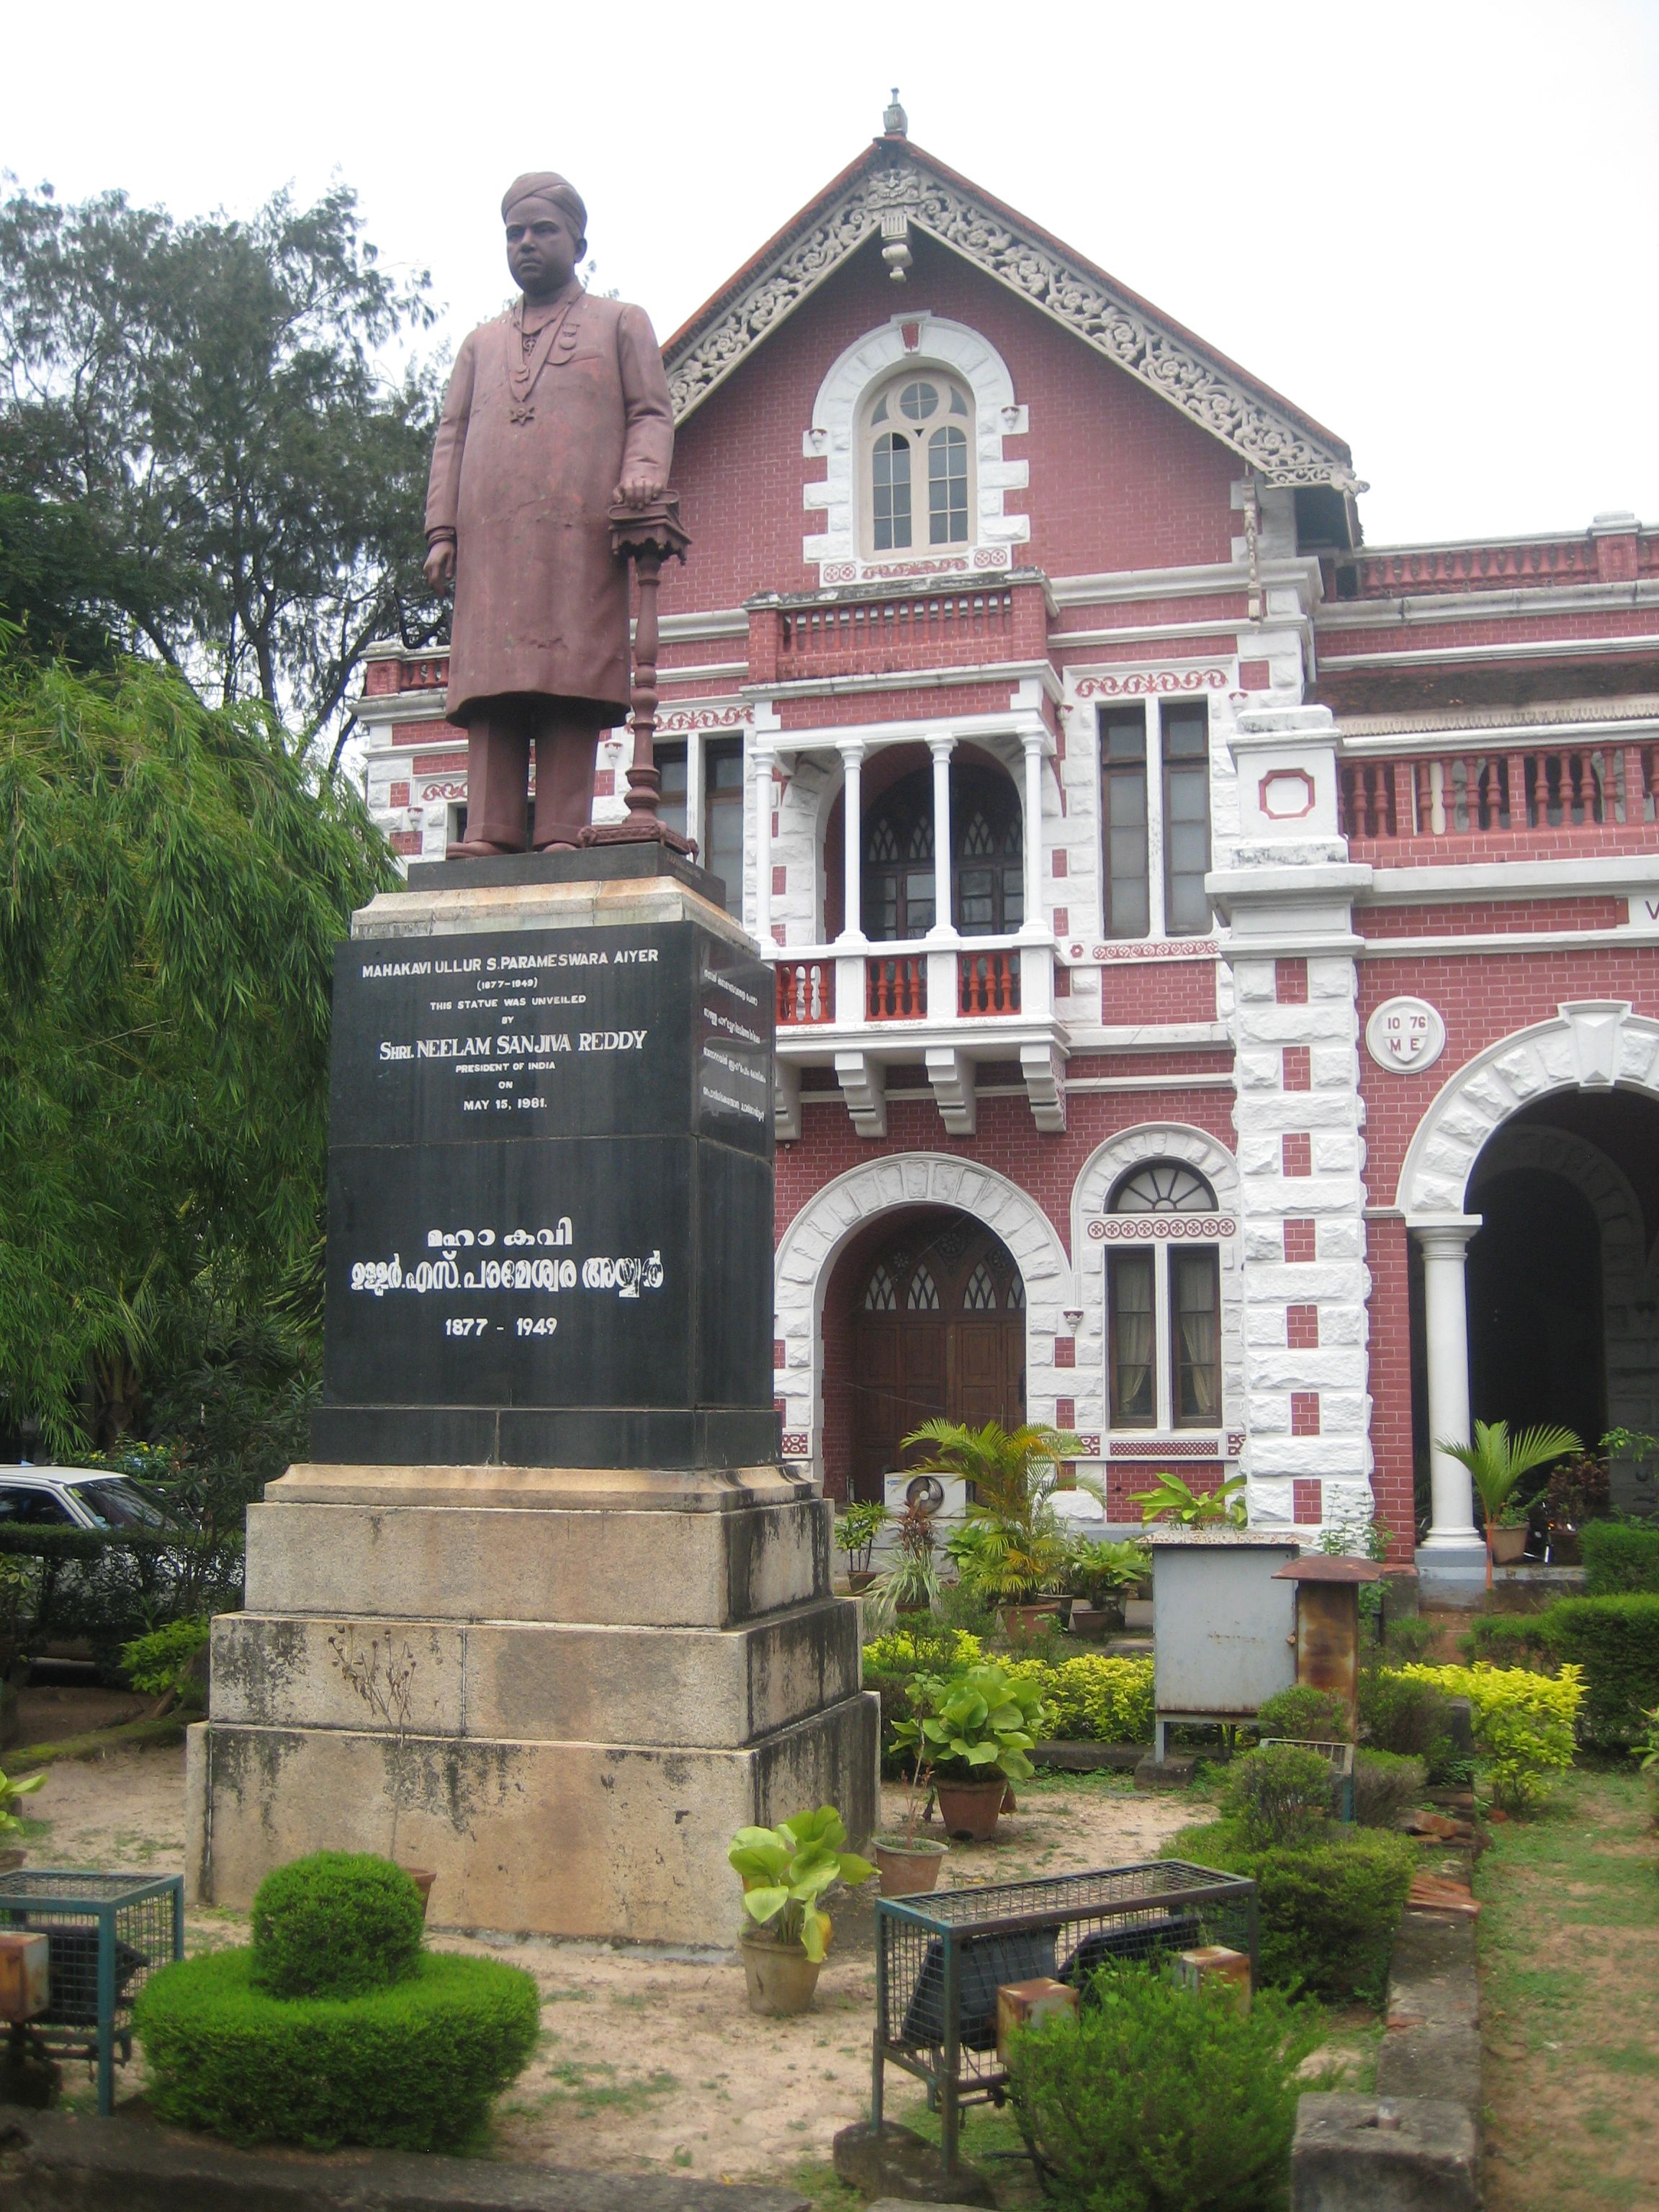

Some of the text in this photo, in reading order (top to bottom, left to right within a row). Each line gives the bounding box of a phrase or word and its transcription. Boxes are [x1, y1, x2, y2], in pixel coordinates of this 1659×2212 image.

[362, 949, 659, 978] MAHAKAVI ULLUR S.PARAMESWARA AIYER
[430, 994, 587, 1011] THIS STATUE WAS UNVEILED
[501, 1016, 514, 1025] BY
[1409, 1016, 1426, 1028] 76
[416, 1036, 492, 1058] NEELAM
[496, 1033, 572, 1055] SANJIVA
[577, 1030, 648, 1051] REDDY
[1390, 1038, 1420, 1051] M E
[455, 1061, 556, 1074] PRESIDENT OF INDIA
[498, 1081, 513, 1089] ON
[463, 1100, 490, 1111] MAY
[517, 1097, 547, 1109] 1981.
[445, 1318, 488, 1336] 1877
[516, 1317, 557, 1336] 1949
